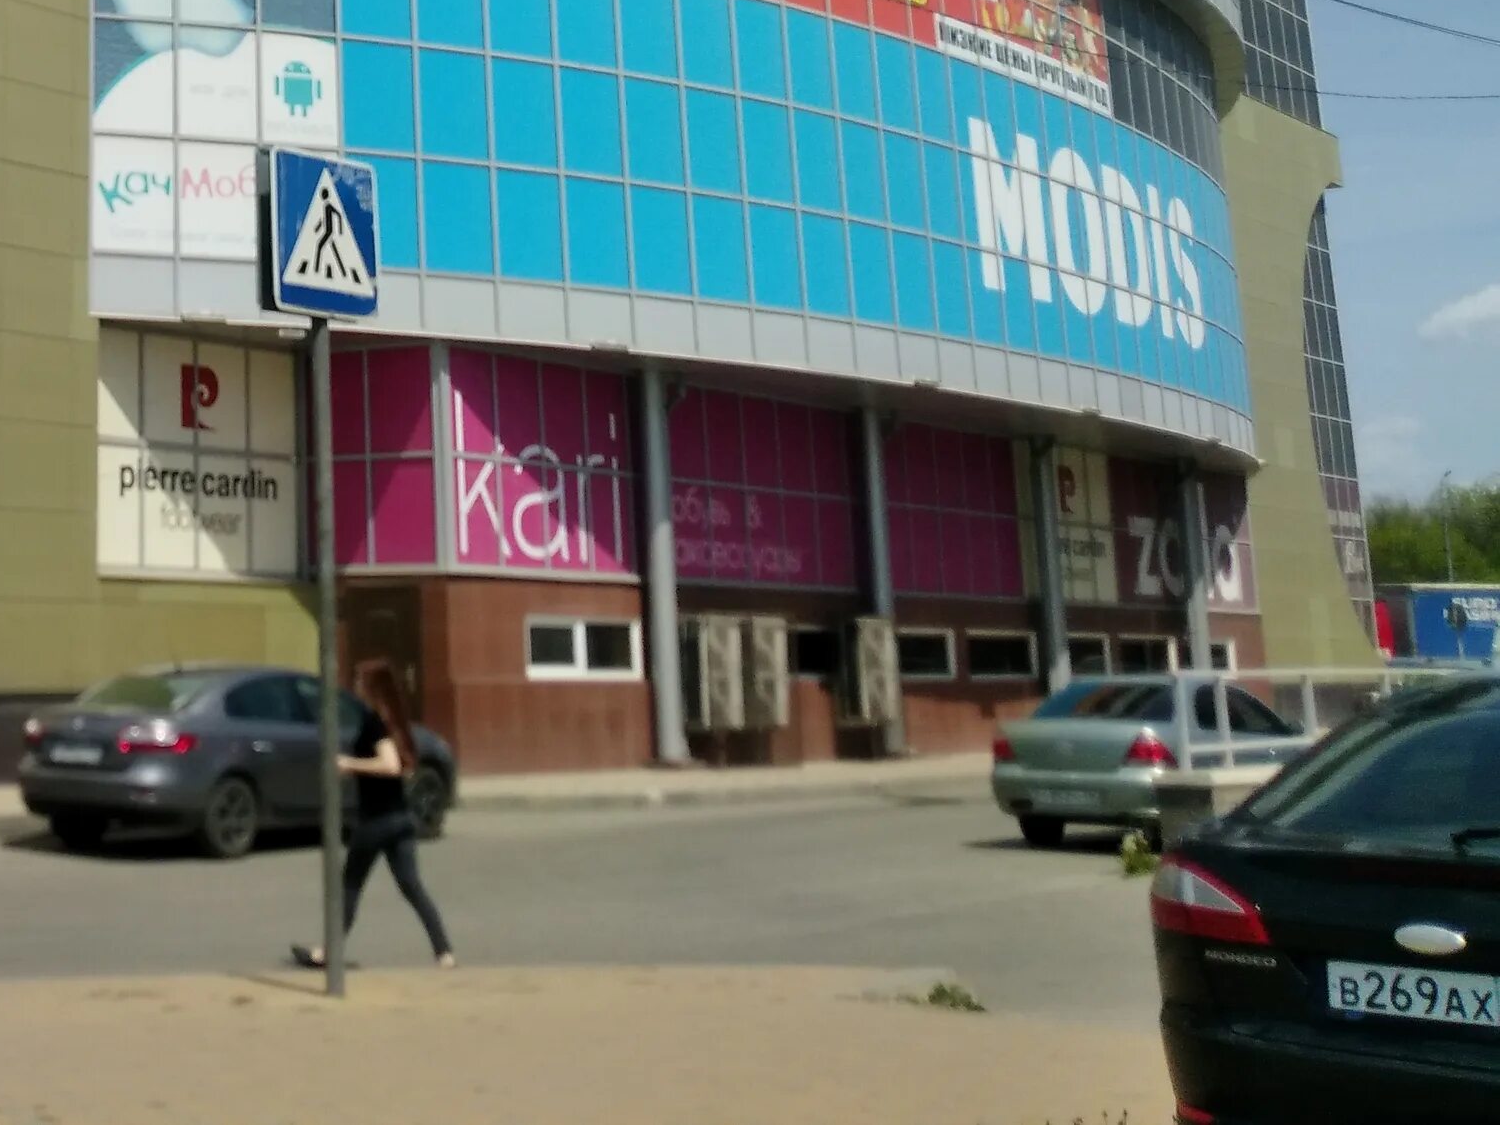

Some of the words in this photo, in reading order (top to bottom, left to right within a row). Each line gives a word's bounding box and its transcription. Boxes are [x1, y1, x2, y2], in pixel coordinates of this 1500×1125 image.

[967, 116, 1205, 350] MODIS
[120, 460, 197, 498] pierre
[201, 463, 278, 501] cardin
[453, 388, 624, 563] kari
